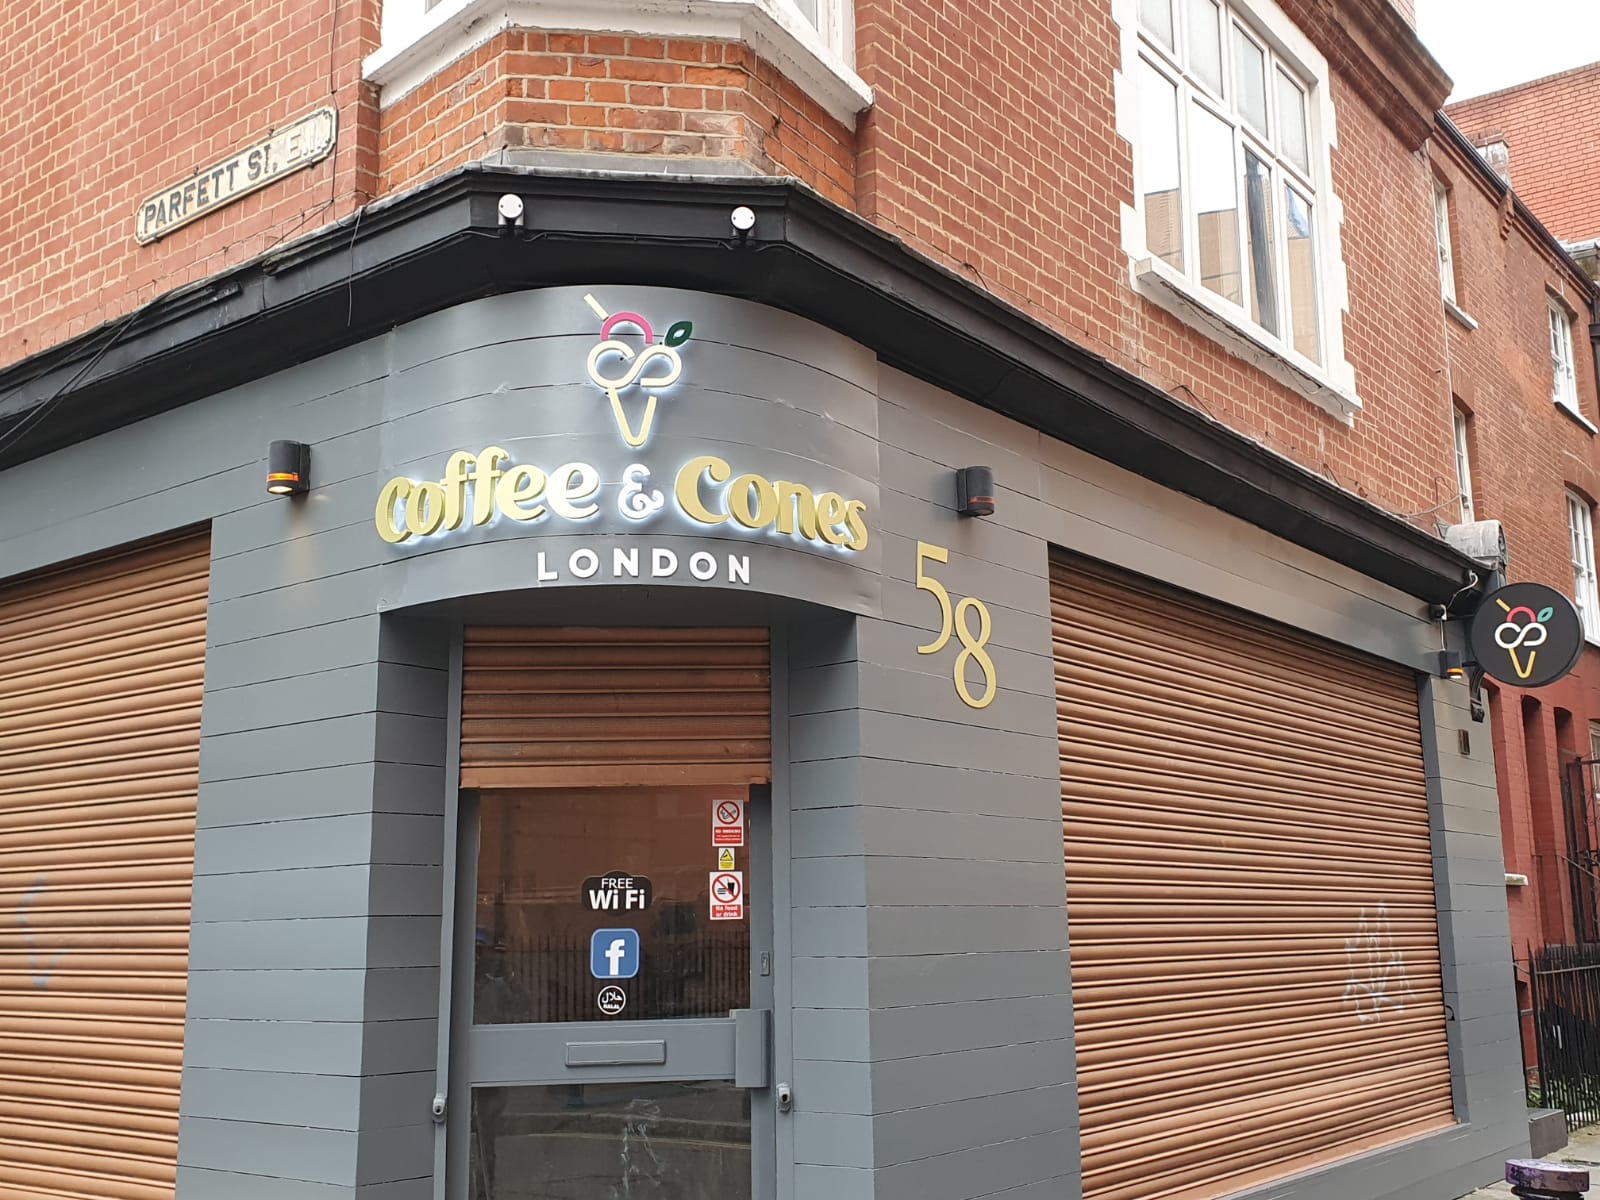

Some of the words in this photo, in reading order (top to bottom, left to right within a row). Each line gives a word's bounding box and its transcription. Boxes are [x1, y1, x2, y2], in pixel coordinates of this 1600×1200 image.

[143, 160, 240, 234] PARFETT
[617, 463, 665, 520] &
[675, 455, 869, 552] Cones
[537, 547, 752, 585] LONDON
[916, 540, 997, 709] 58
[589, 889, 619, 910] Wi
[625, 889, 645, 910] Fi
[601, 877, 634, 889] FREE
